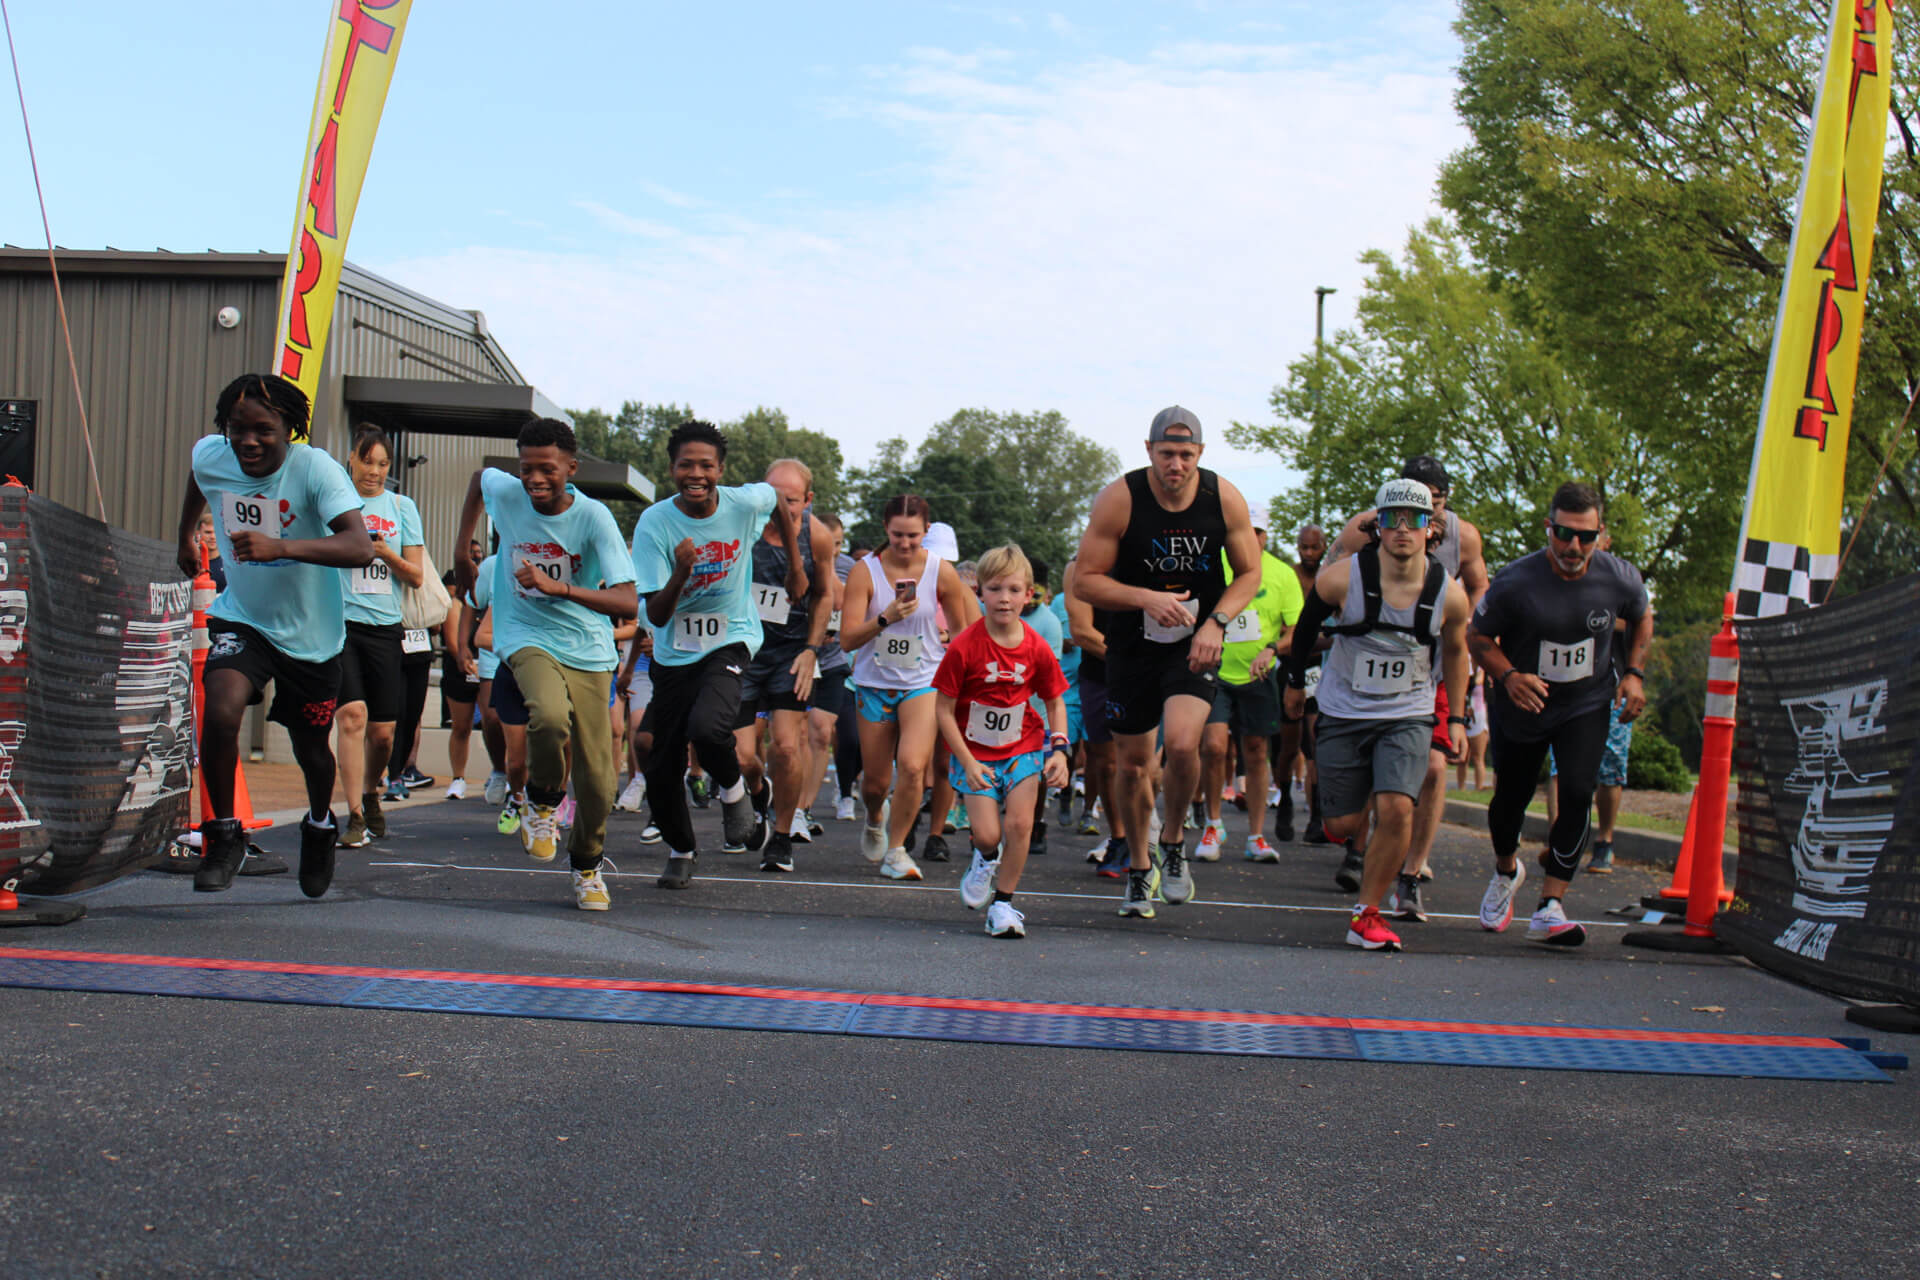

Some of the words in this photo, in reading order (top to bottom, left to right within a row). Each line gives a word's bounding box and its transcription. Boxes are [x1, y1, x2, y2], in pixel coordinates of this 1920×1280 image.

[1384, 487, 1427, 506] Yankees
[235, 501, 262, 526] 99
[1152, 536, 1208, 557] NEW
[361, 563, 388, 580] 109
[1144, 554, 1211, 573] YORK
[406, 630, 426, 643] 123
[683, 617, 719, 637] 110
[887, 639, 910, 655] 89
[1549, 646, 1586, 667] 118
[1365, 658, 1406, 679] 119
[984, 710, 1011, 731] 90
